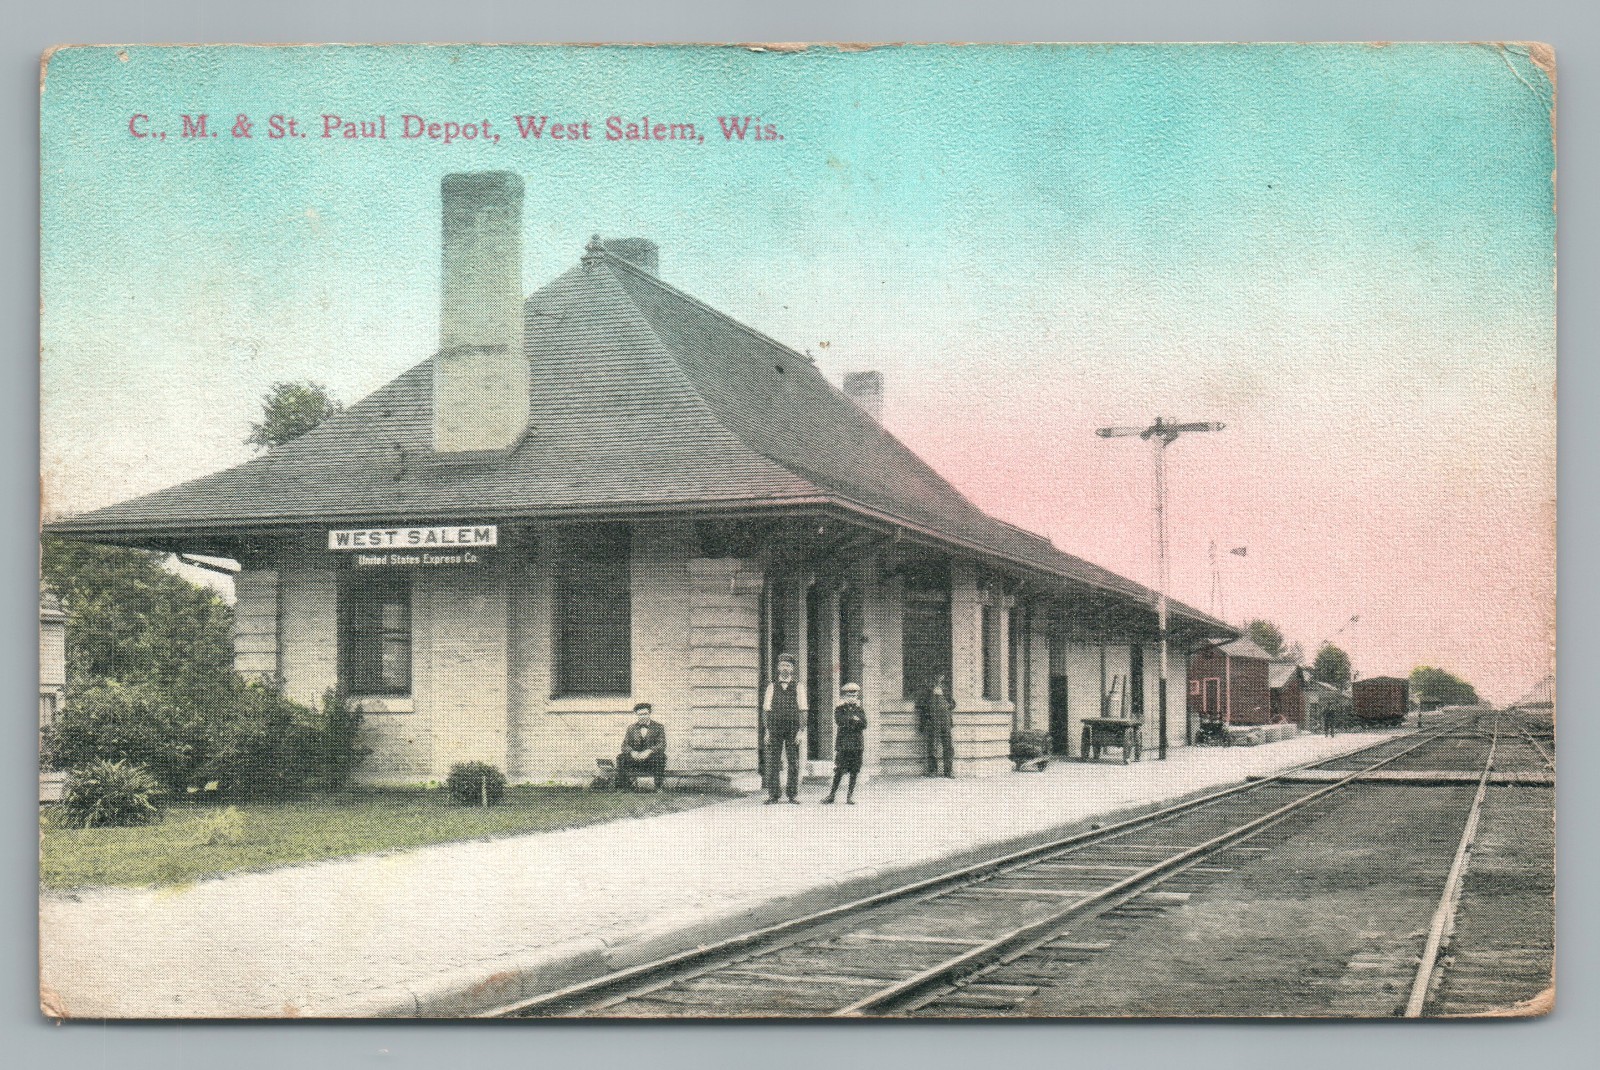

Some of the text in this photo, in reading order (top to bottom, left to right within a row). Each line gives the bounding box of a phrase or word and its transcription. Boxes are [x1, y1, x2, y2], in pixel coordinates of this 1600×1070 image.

[336, 527, 490, 547] WEST SALEM
[358, 554, 387, 565] United
[390, 554, 420, 565] States
[423, 553, 461, 566] Express
